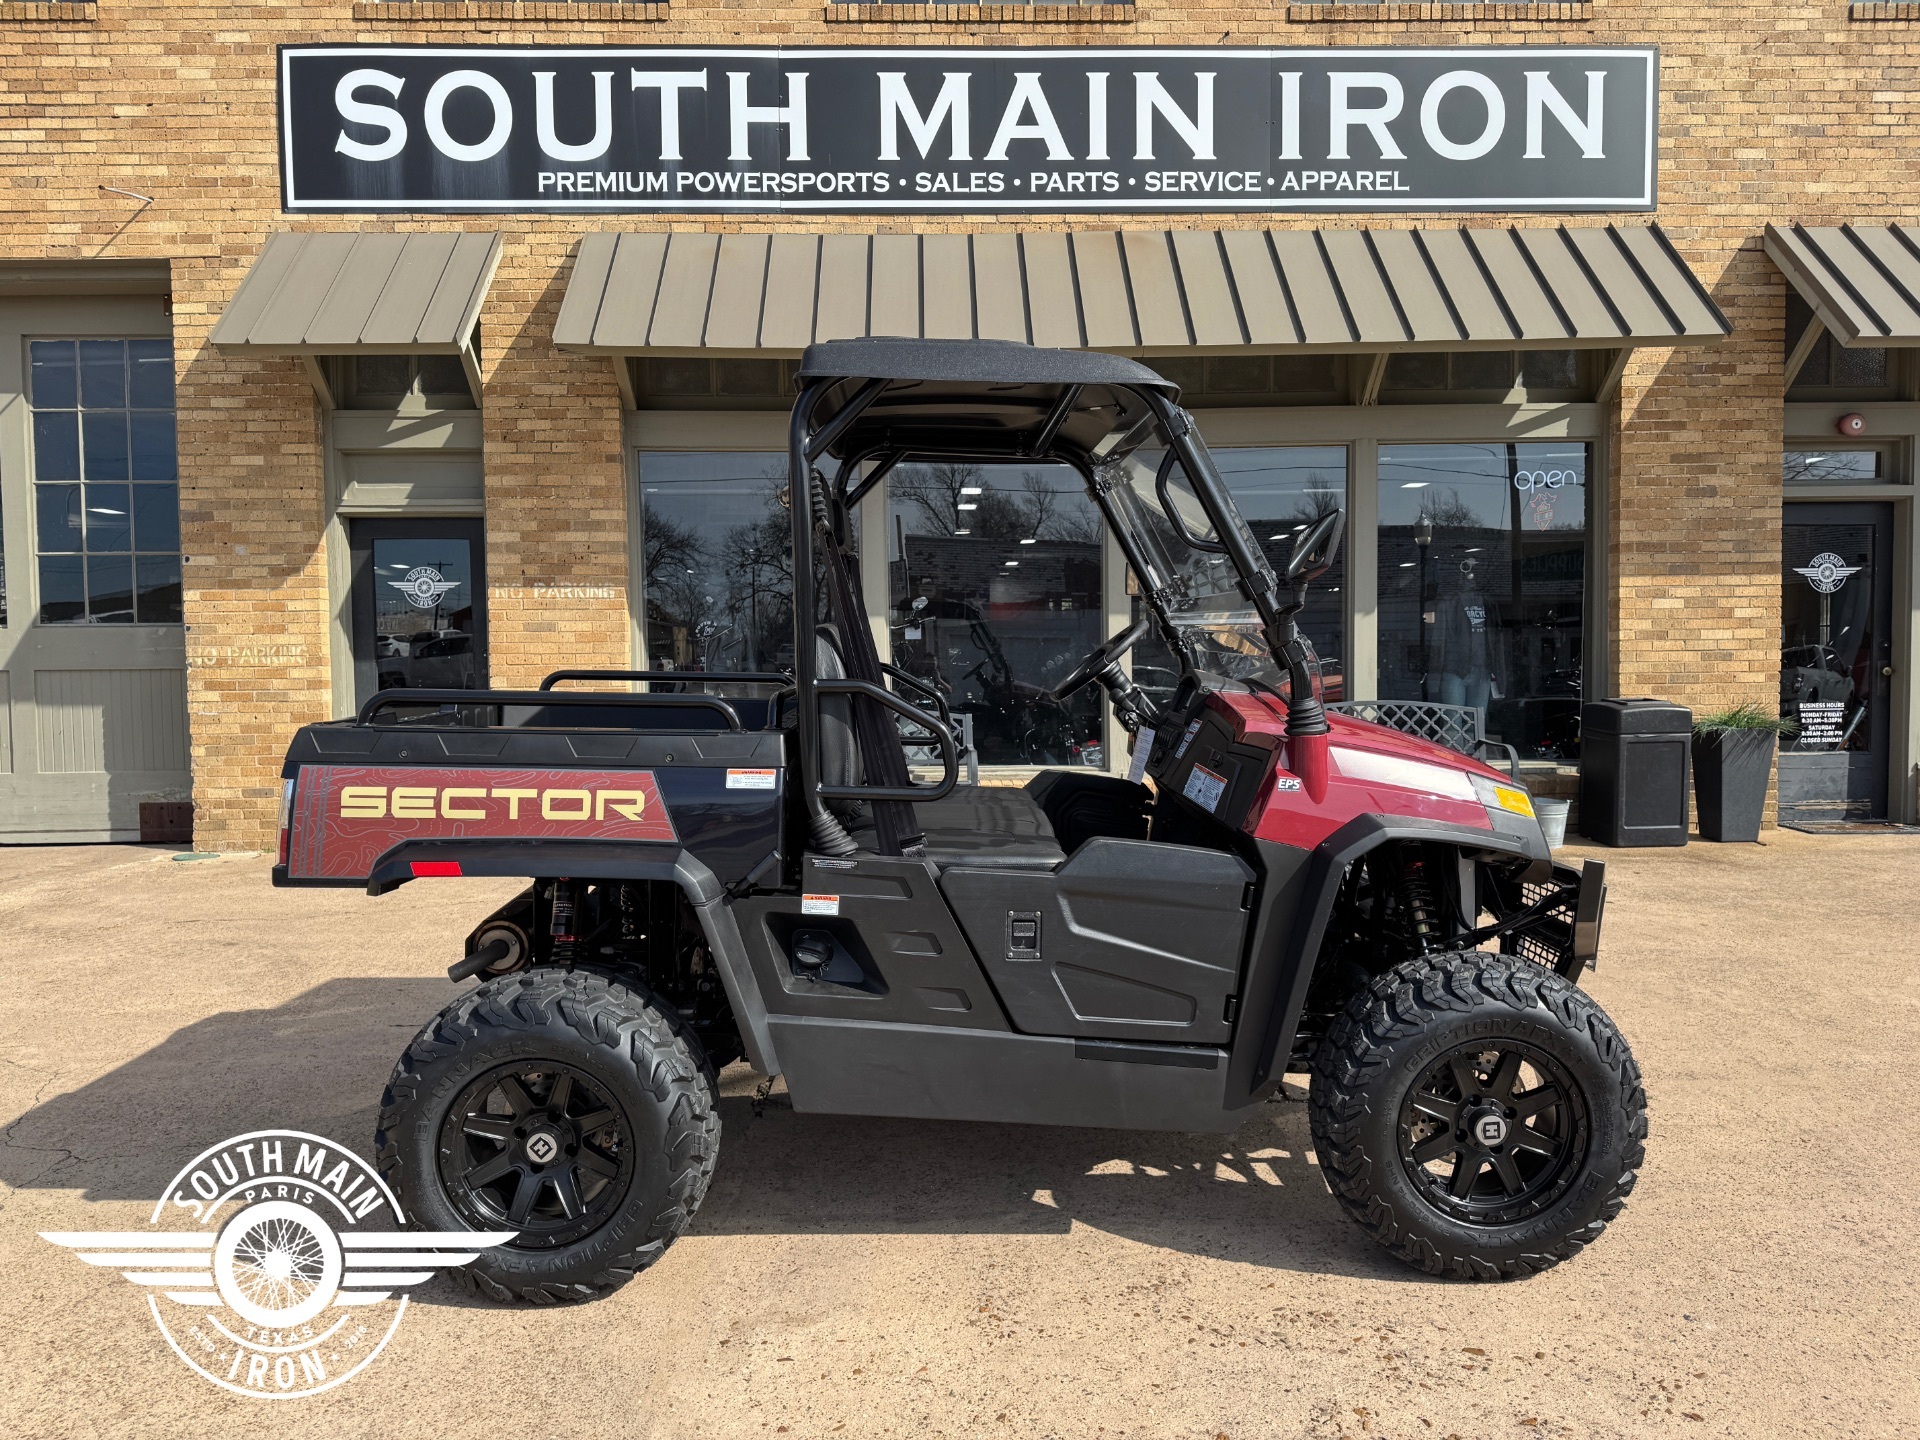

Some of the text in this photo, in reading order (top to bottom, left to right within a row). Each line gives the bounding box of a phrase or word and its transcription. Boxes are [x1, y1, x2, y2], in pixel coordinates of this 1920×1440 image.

[334, 68, 1606, 162] SOUTH MAIN IRON
[537, 170, 1409, 193] PREMIUM POWERSPORTS SALES PARTS SERVICE APPAREL
[1514, 470, 1576, 494] open
[408, 569, 426, 581] SOUTH
[426, 569, 441, 581] MAIN
[495, 582, 616, 599] NO PARKING
[187, 645, 307, 665] NO PARKING
[1278, 778, 1300, 789] EPS
[340, 786, 645, 821] SECTOR
